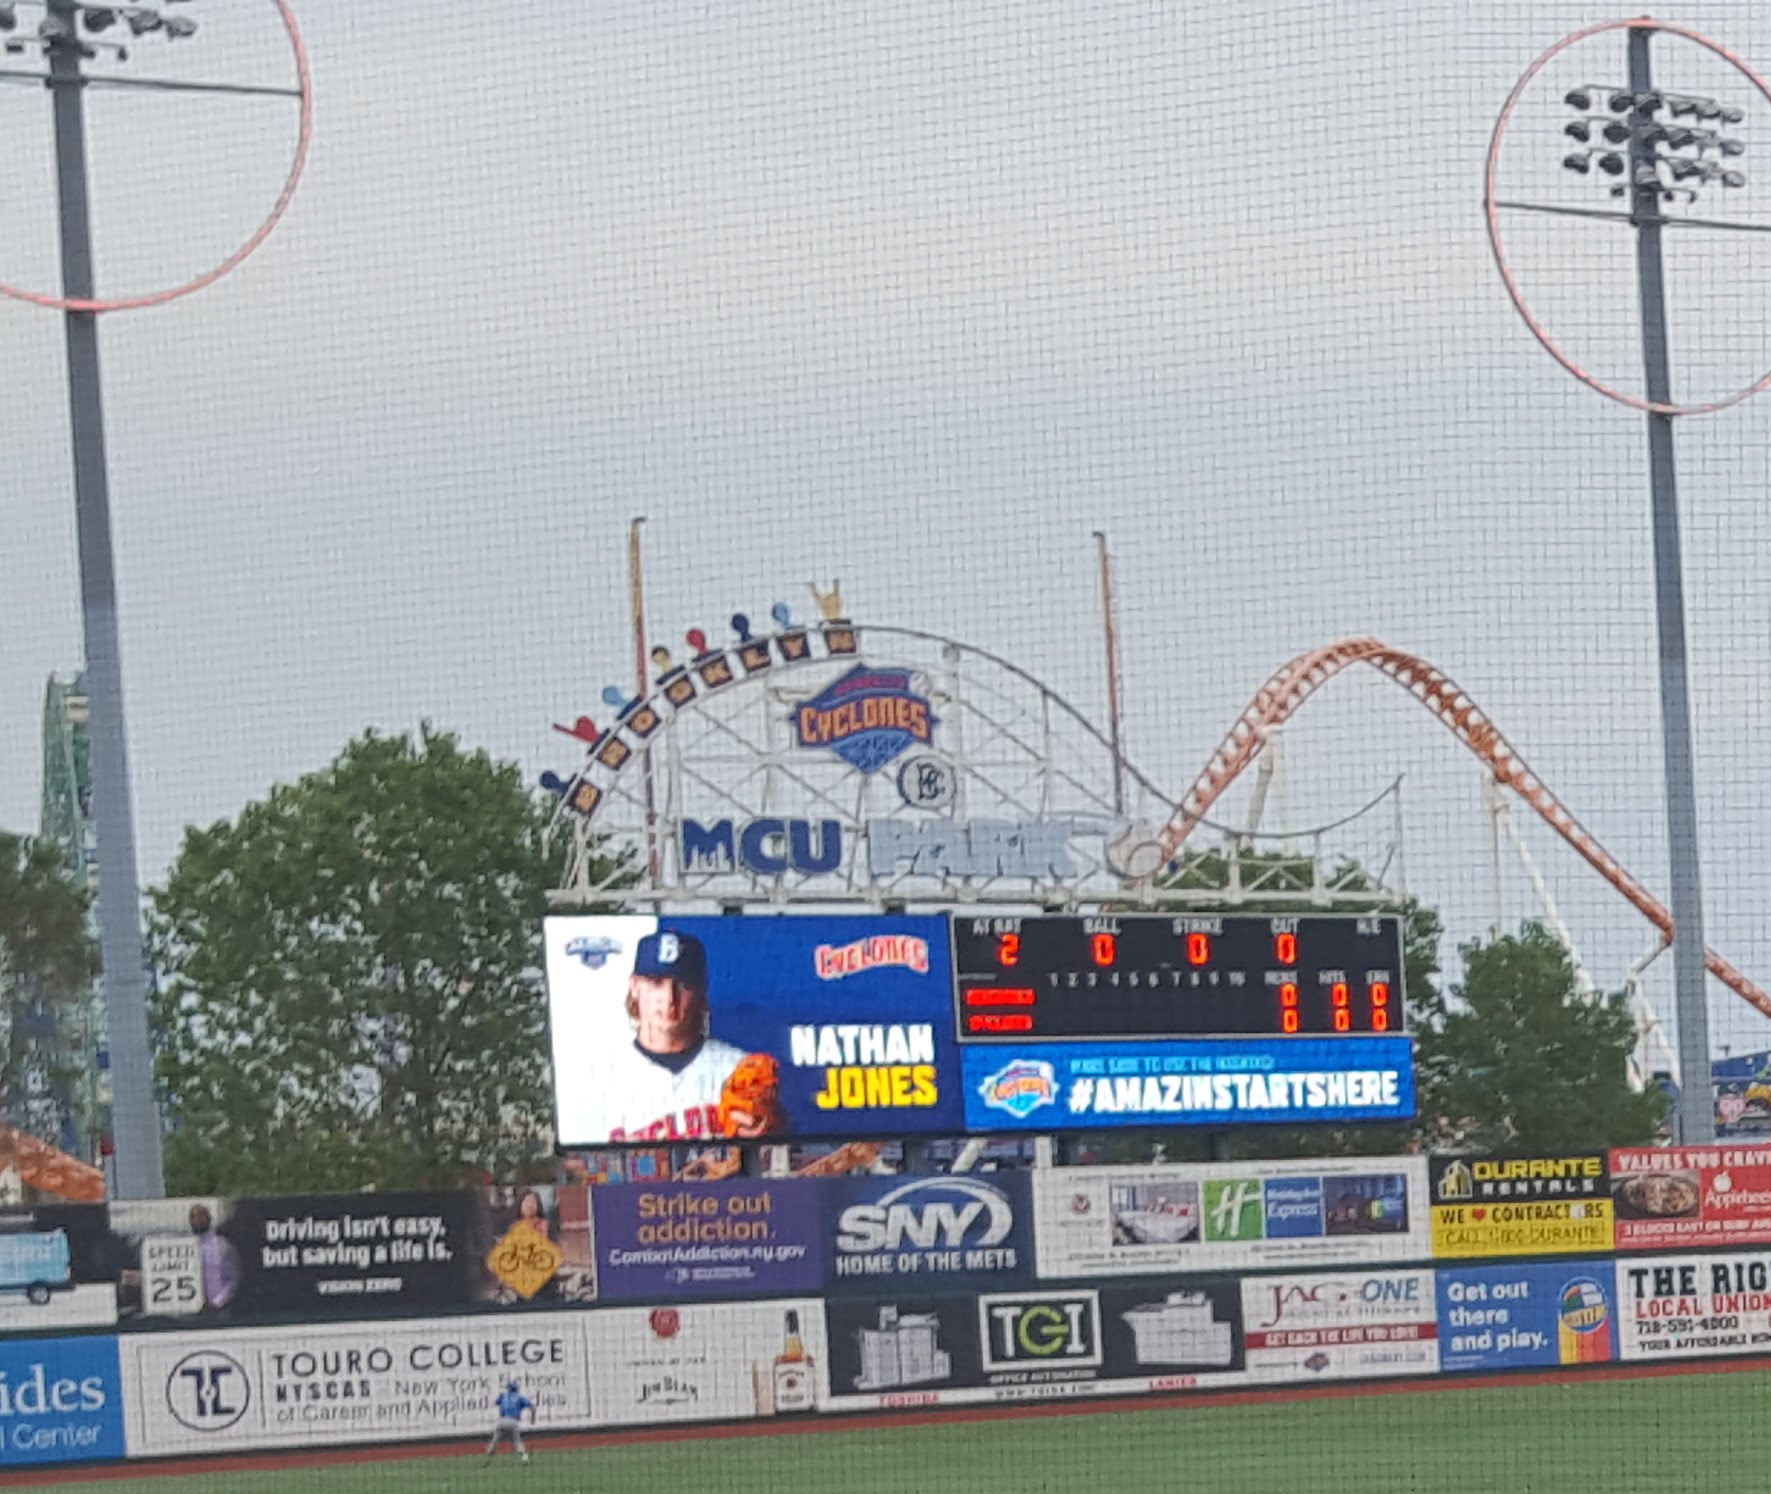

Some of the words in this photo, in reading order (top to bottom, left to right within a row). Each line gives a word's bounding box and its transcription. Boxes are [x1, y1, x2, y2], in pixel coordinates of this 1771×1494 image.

[801, 697, 928, 743] CYCLONES
[682, 818, 842, 875] MCU
[868, 819, 1078, 878] PARK
[1084, 918, 1121, 934] BALL
[1173, 918, 1222, 934] STRIKE
[1271, 918, 1299, 933] OUT
[659, 933, 679, 963] B
[814, 934, 928, 980] CYCLONES
[1000, 933, 1019, 966] 2
[1093, 933, 1115, 965] 0
[1187, 933, 1208, 965] 0
[1277, 933, 1296, 964] 0
[1280, 983, 1297, 1007] 0
[1332, 983, 1347, 1007] 0
[1372, 982, 1387, 1006] 0
[1282, 1009, 1297, 1032] 0
[1335, 1008, 1349, 1032] 0
[1372, 1008, 1387, 1031] 0
[791, 1024, 934, 1066] NATHAN
[816, 1065, 938, 1109] JONES
[1068, 1071, 1399, 1112] #AMAZINSTARTSHERE
[1472, 1157, 1603, 1180] DURANTE
[1619, 1152, 1684, 1171] VALUES
[1688, 1151, 1719, 1169] YOU
[1482, 1178, 1595, 1196] RENTALS
[638, 1193, 719, 1219] Strike
[728, 1191, 772, 1215] out
[1440, 1208, 1465, 1224] WE
[266, 1218, 339, 1242] Driving
[344, 1214, 389, 1238] isn't
[638, 1217, 777, 1245] addiction.
[836, 1202, 992, 1251] SNY
[151, 1246, 194, 1259] SPEED
[263, 1245, 299, 1268] but
[302, 1243, 371, 1268] saving
[374, 1246, 388, 1262] a
[391, 1240, 423, 1262] life
[836, 1253, 893, 1276] HOME
[899, 1252, 922, 1271] OF
[925, 1251, 961, 1270] THE
[966, 1249, 1017, 1269] METS
[152, 1276, 197, 1303] 25
[1361, 1277, 1420, 1301] ONE
[1448, 1282, 1488, 1302] Get
[1491, 1280, 1529, 1299] out
[1629, 1265, 1697, 1298] THE
[1449, 1305, 1509, 1328] there
[1636, 1298, 1703, 1319] LOCAL
[991, 1303, 1086, 1358] TGI
[1450, 1329, 1493, 1352] and
[1496, 1327, 1549, 1353] play.
[272, 1347, 393, 1379] TOURO
[409, 1339, 565, 1371] COLLEGE
[396, 1379, 439, 1397] New
[448, 1377, 490, 1395] York
[1151, 1376, 1197, 1390] LANIER
[375, 1399, 412, 1420] and
[418, 1393, 489, 1420] Applied
[11, 1420, 102, 1450] Center
